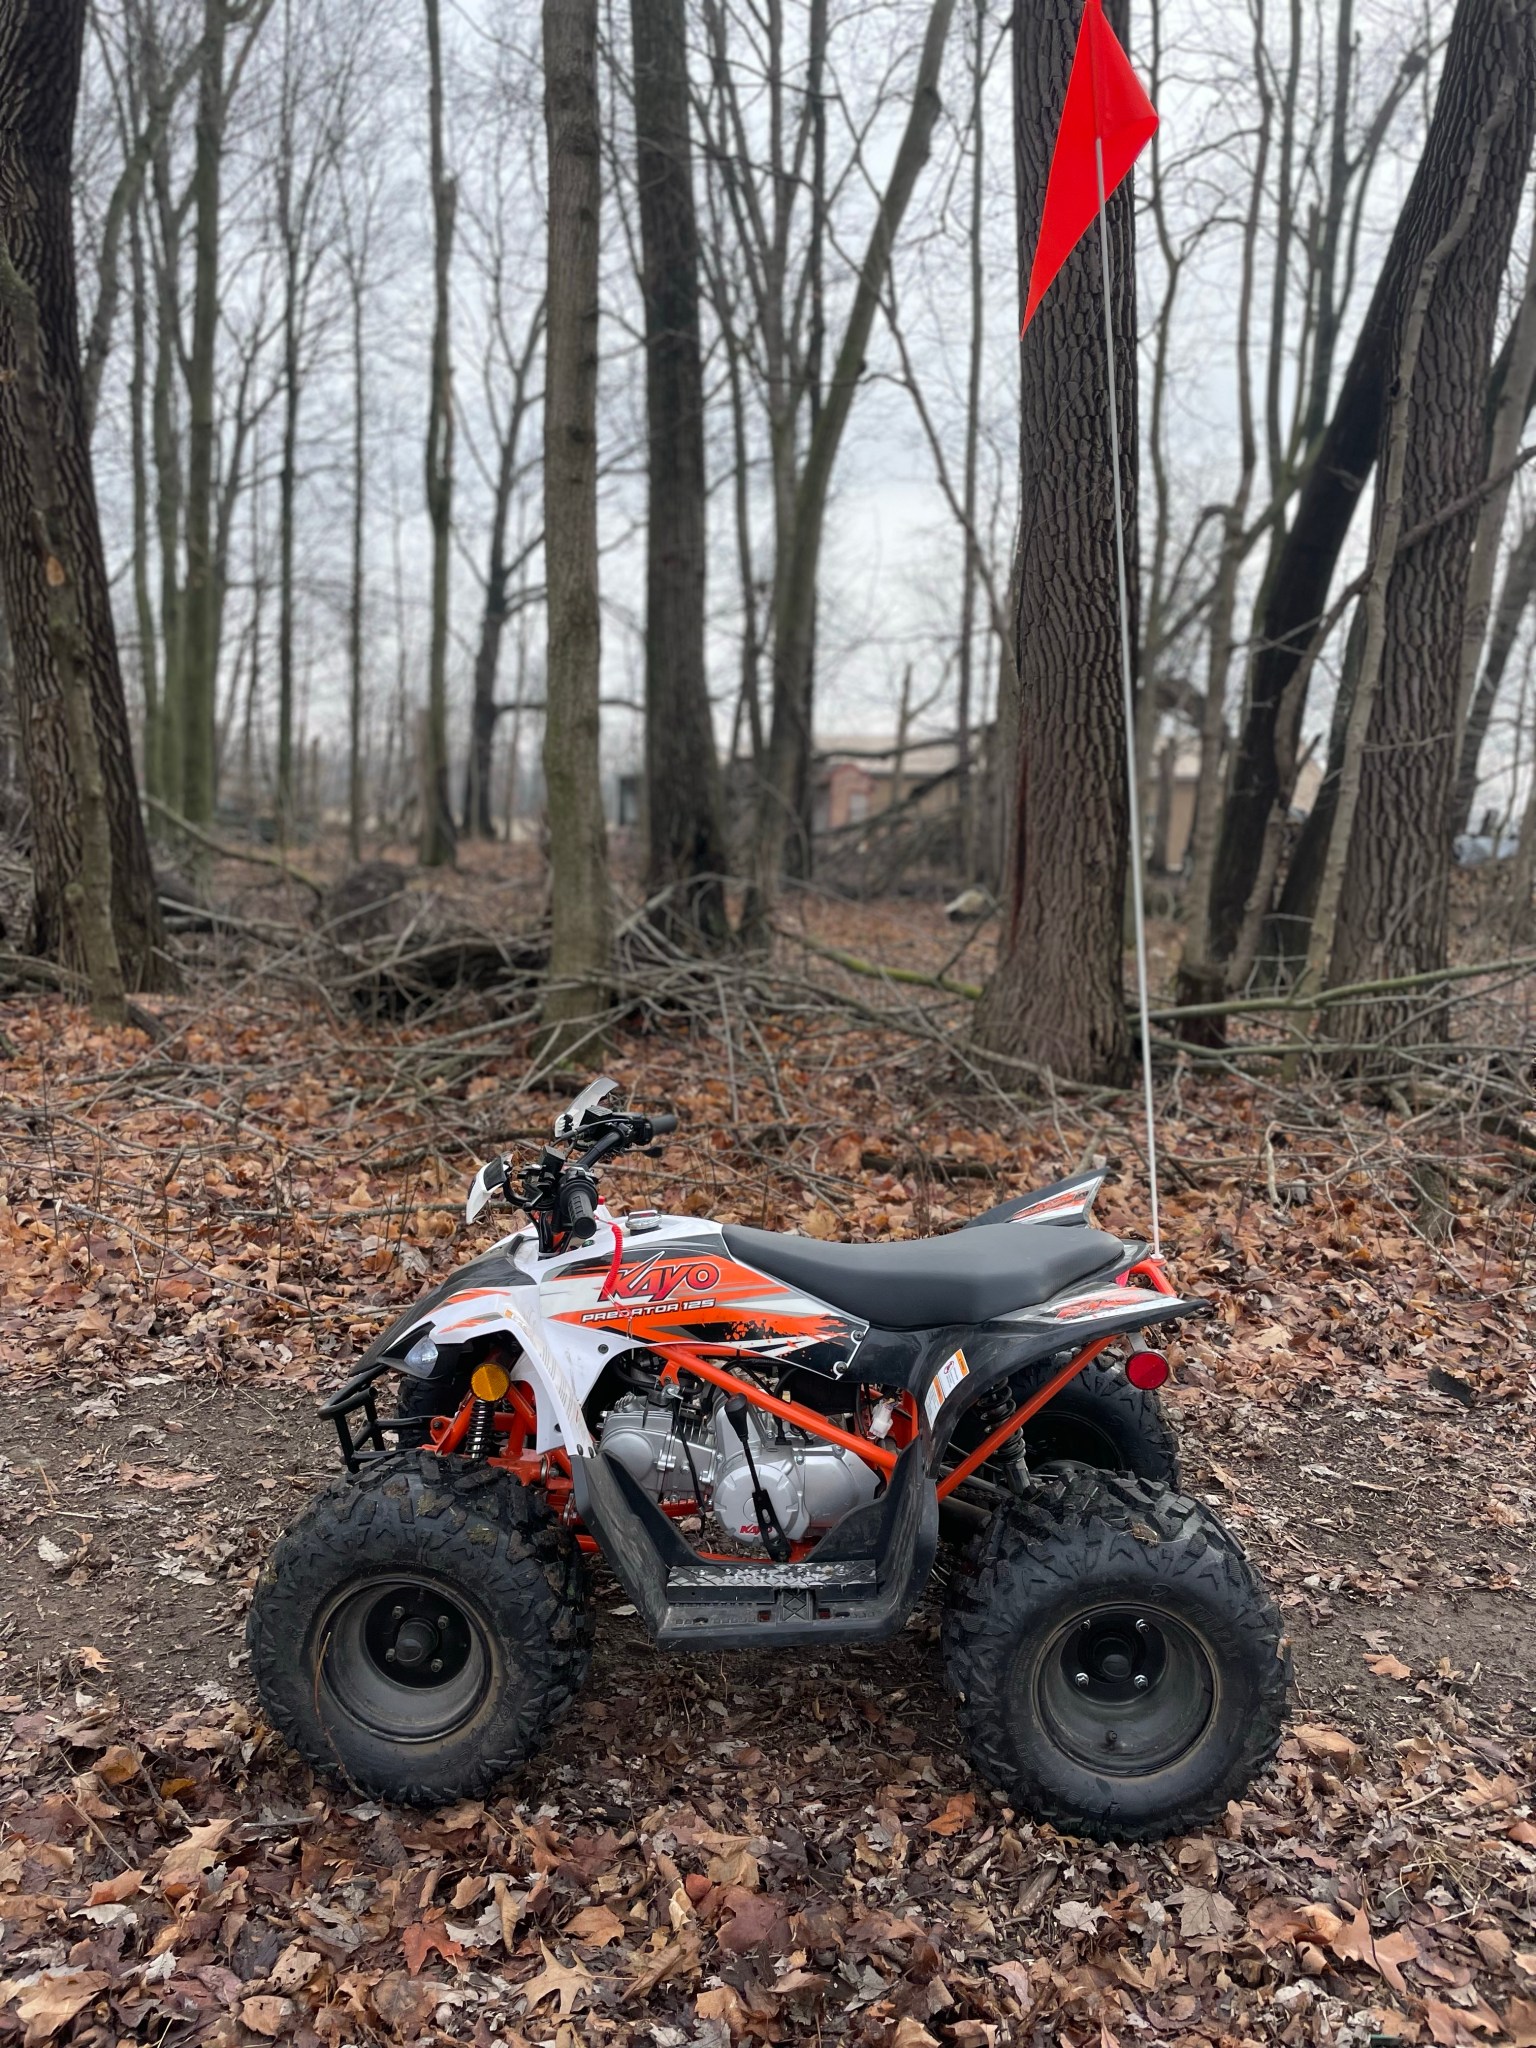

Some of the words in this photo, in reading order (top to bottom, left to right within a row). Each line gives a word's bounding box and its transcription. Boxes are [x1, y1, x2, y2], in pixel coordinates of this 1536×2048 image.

[597, 1251, 720, 1302] KAYO
[582, 1303, 679, 1323] PREDATOR
[683, 1298, 716, 1311] 125
